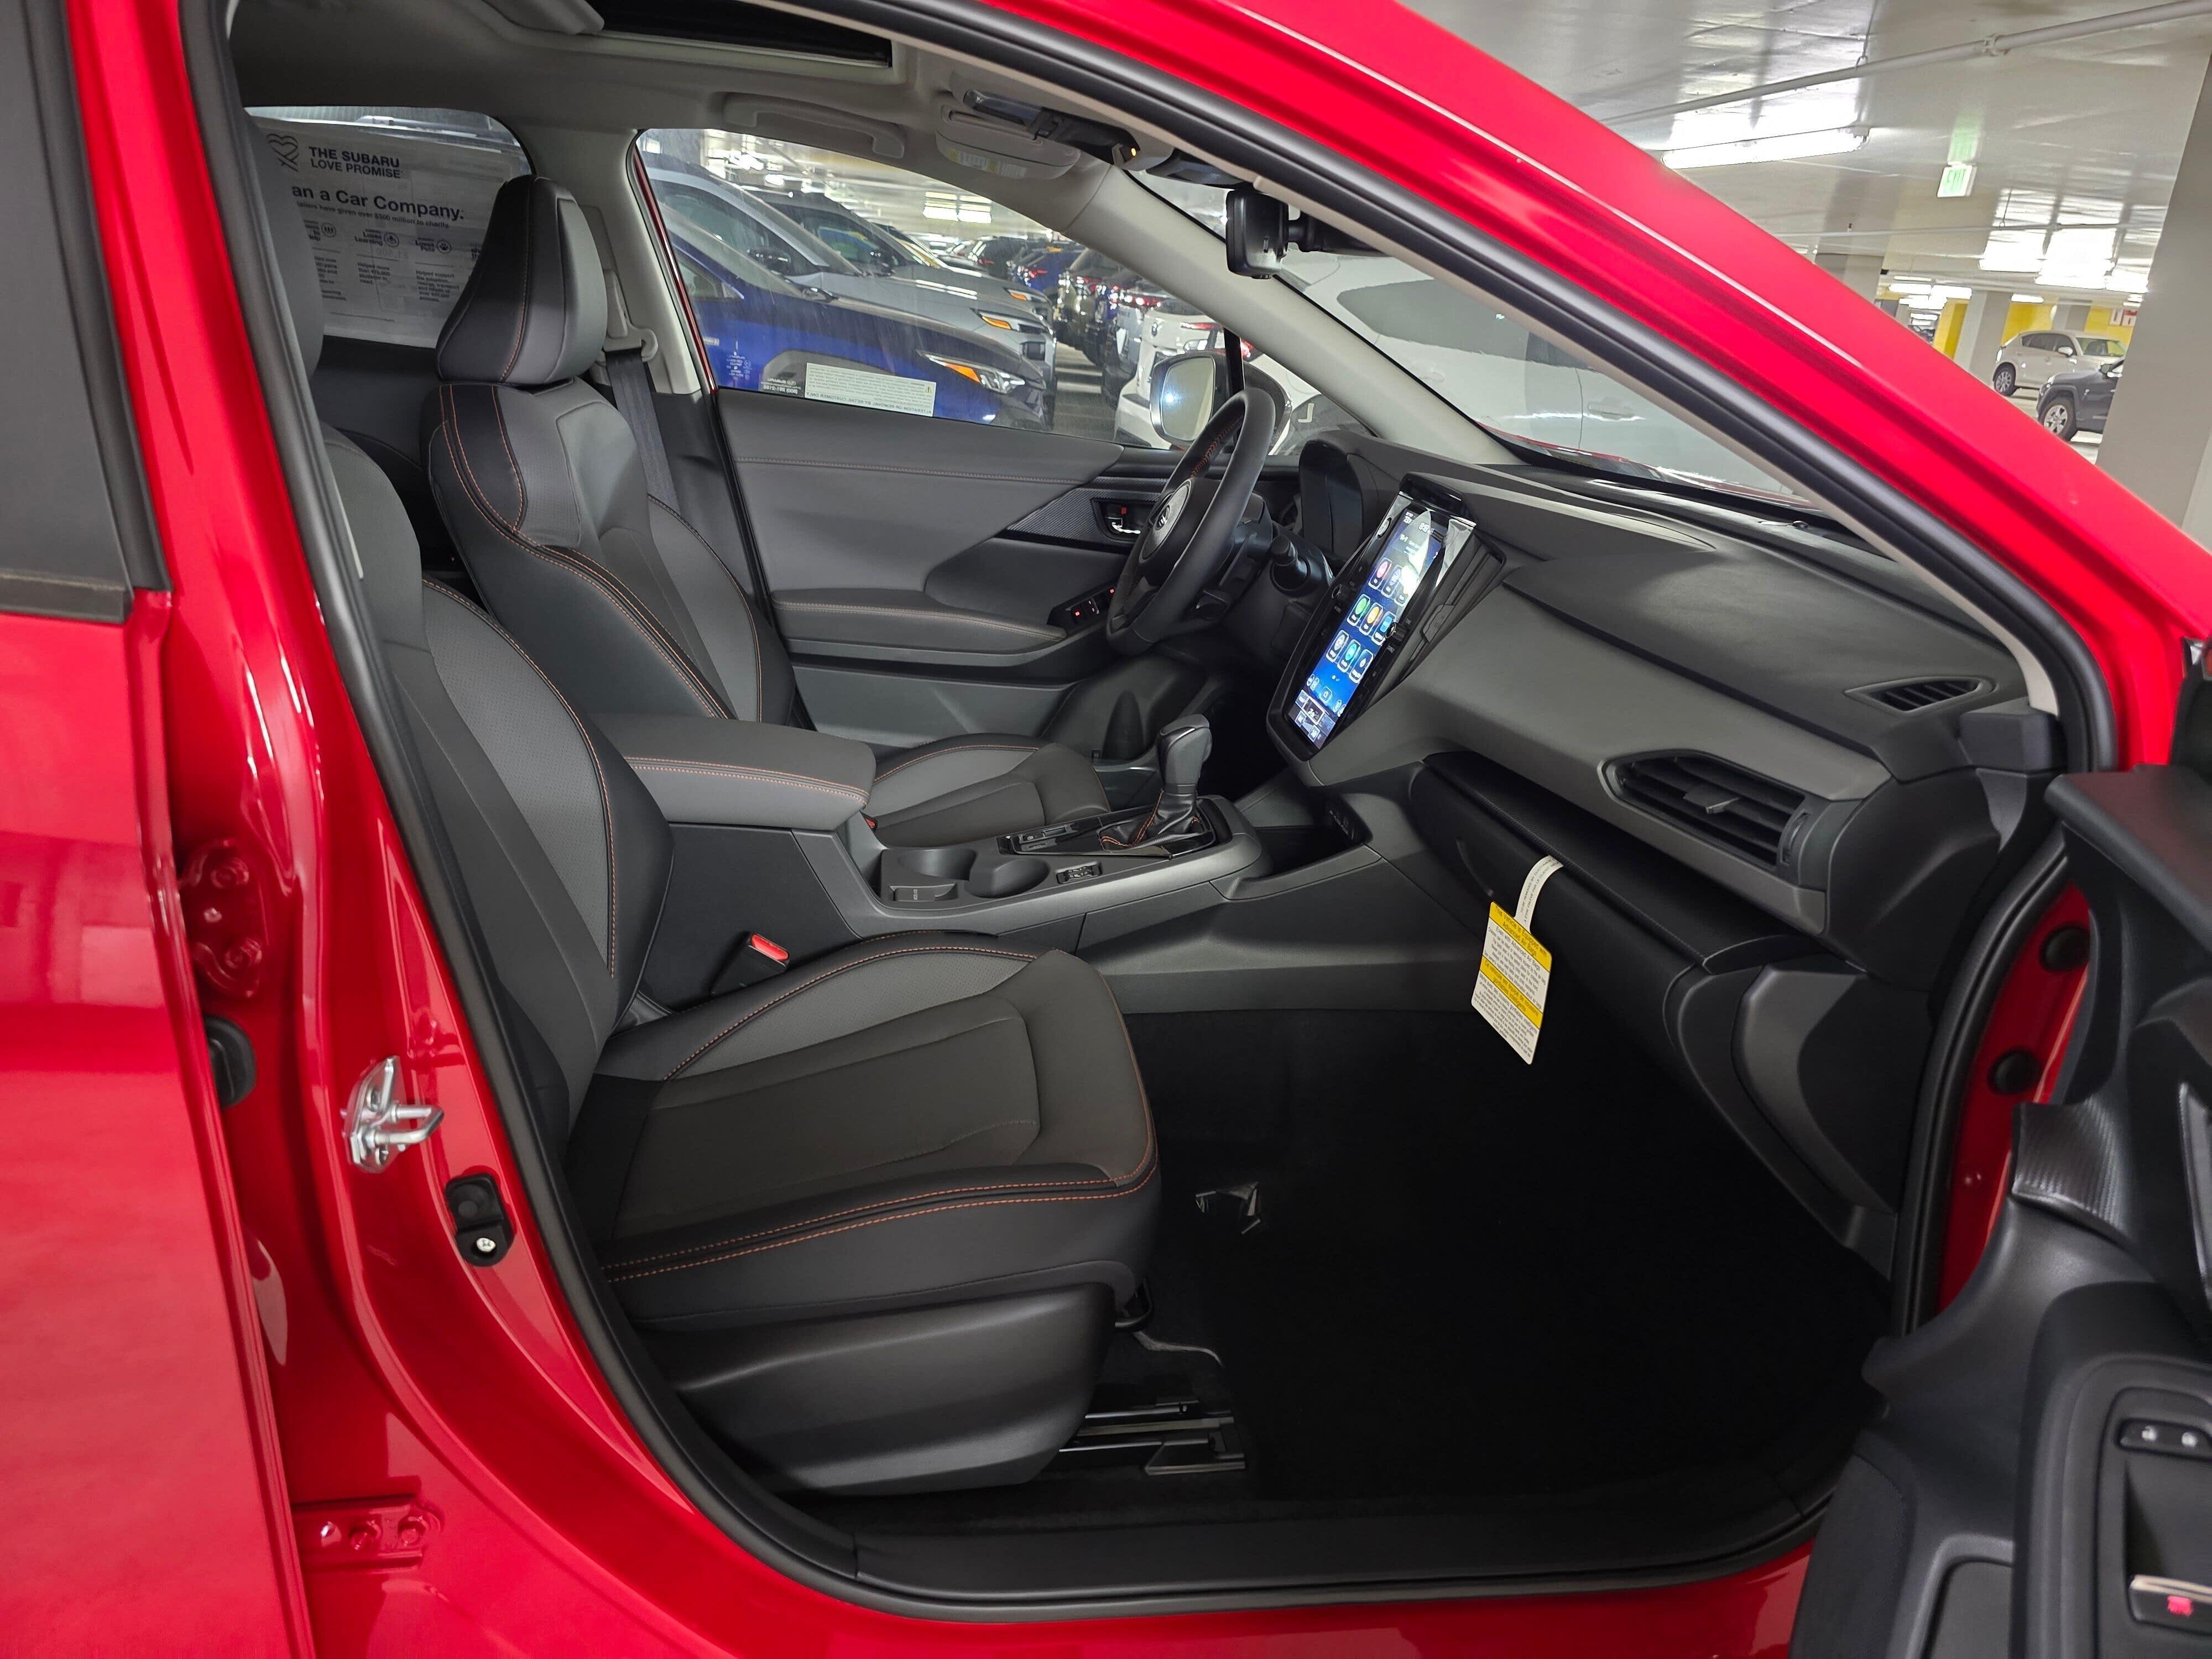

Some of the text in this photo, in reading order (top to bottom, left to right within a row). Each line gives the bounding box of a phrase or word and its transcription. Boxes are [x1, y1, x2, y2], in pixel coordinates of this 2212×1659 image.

[309, 146, 400, 168] THE SUBARU
[310, 158, 401, 179] LOVE PROMISE
[320, 190, 330, 201] a
[336, 190, 368, 207] Car
[337, 207, 356, 215] given
[392, 216, 415, 224] million
[355, 236, 383, 246] Learning
[1494, 905, 1503, 917] This
[1503, 913, 1517, 930] Vehicle
[1511, 940, 1526, 958] Advanced
